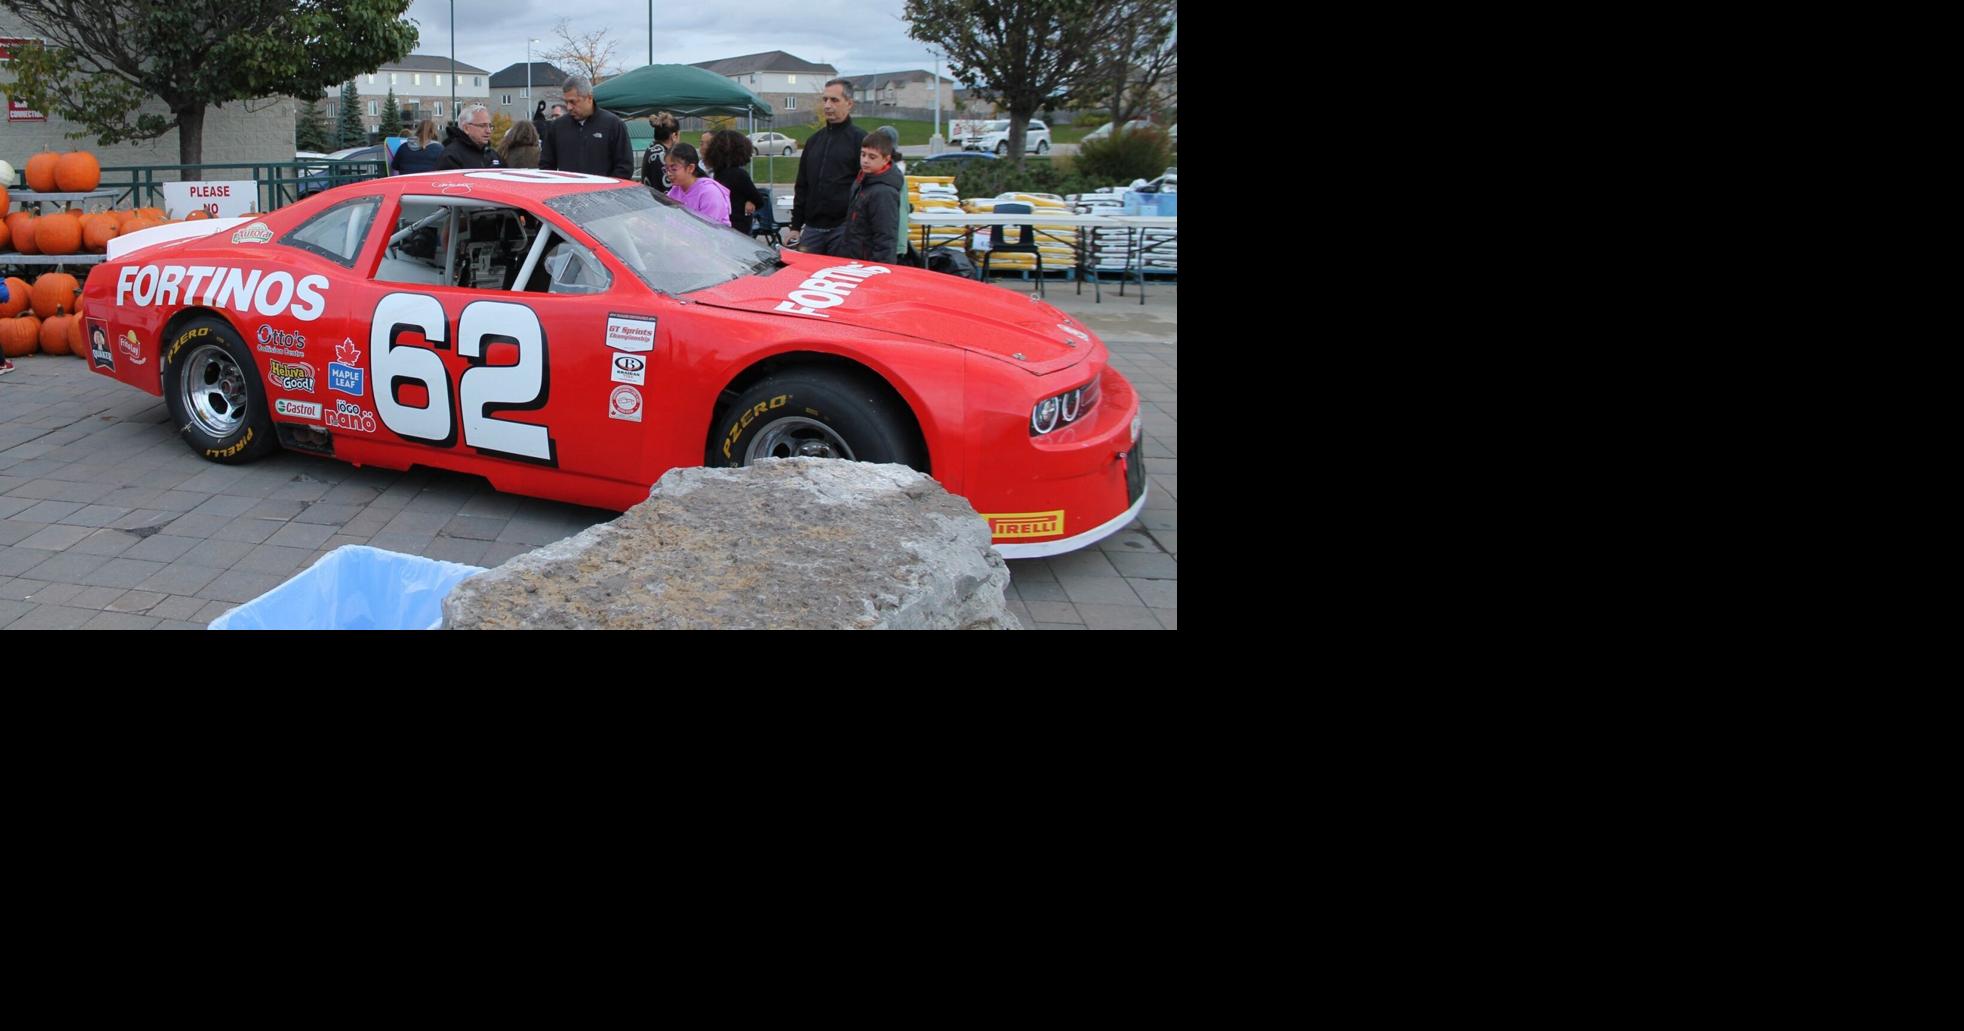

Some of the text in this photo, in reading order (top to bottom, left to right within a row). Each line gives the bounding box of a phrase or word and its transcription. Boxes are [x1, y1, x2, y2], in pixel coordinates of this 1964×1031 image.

[190, 185, 231, 197] PLEASE
[116, 264, 329, 322] FORTINOS
[257, 323, 306, 349] Otto's
[271, 360, 305, 378] Heluva
[332, 369, 359, 381] MAPLE
[283, 376, 314, 392] Good!
[335, 378, 356, 389] LEAF
[370, 292, 557, 465] 62
[286, 402, 315, 416] Castrol
[206, 426, 254, 458] PIRELLI
